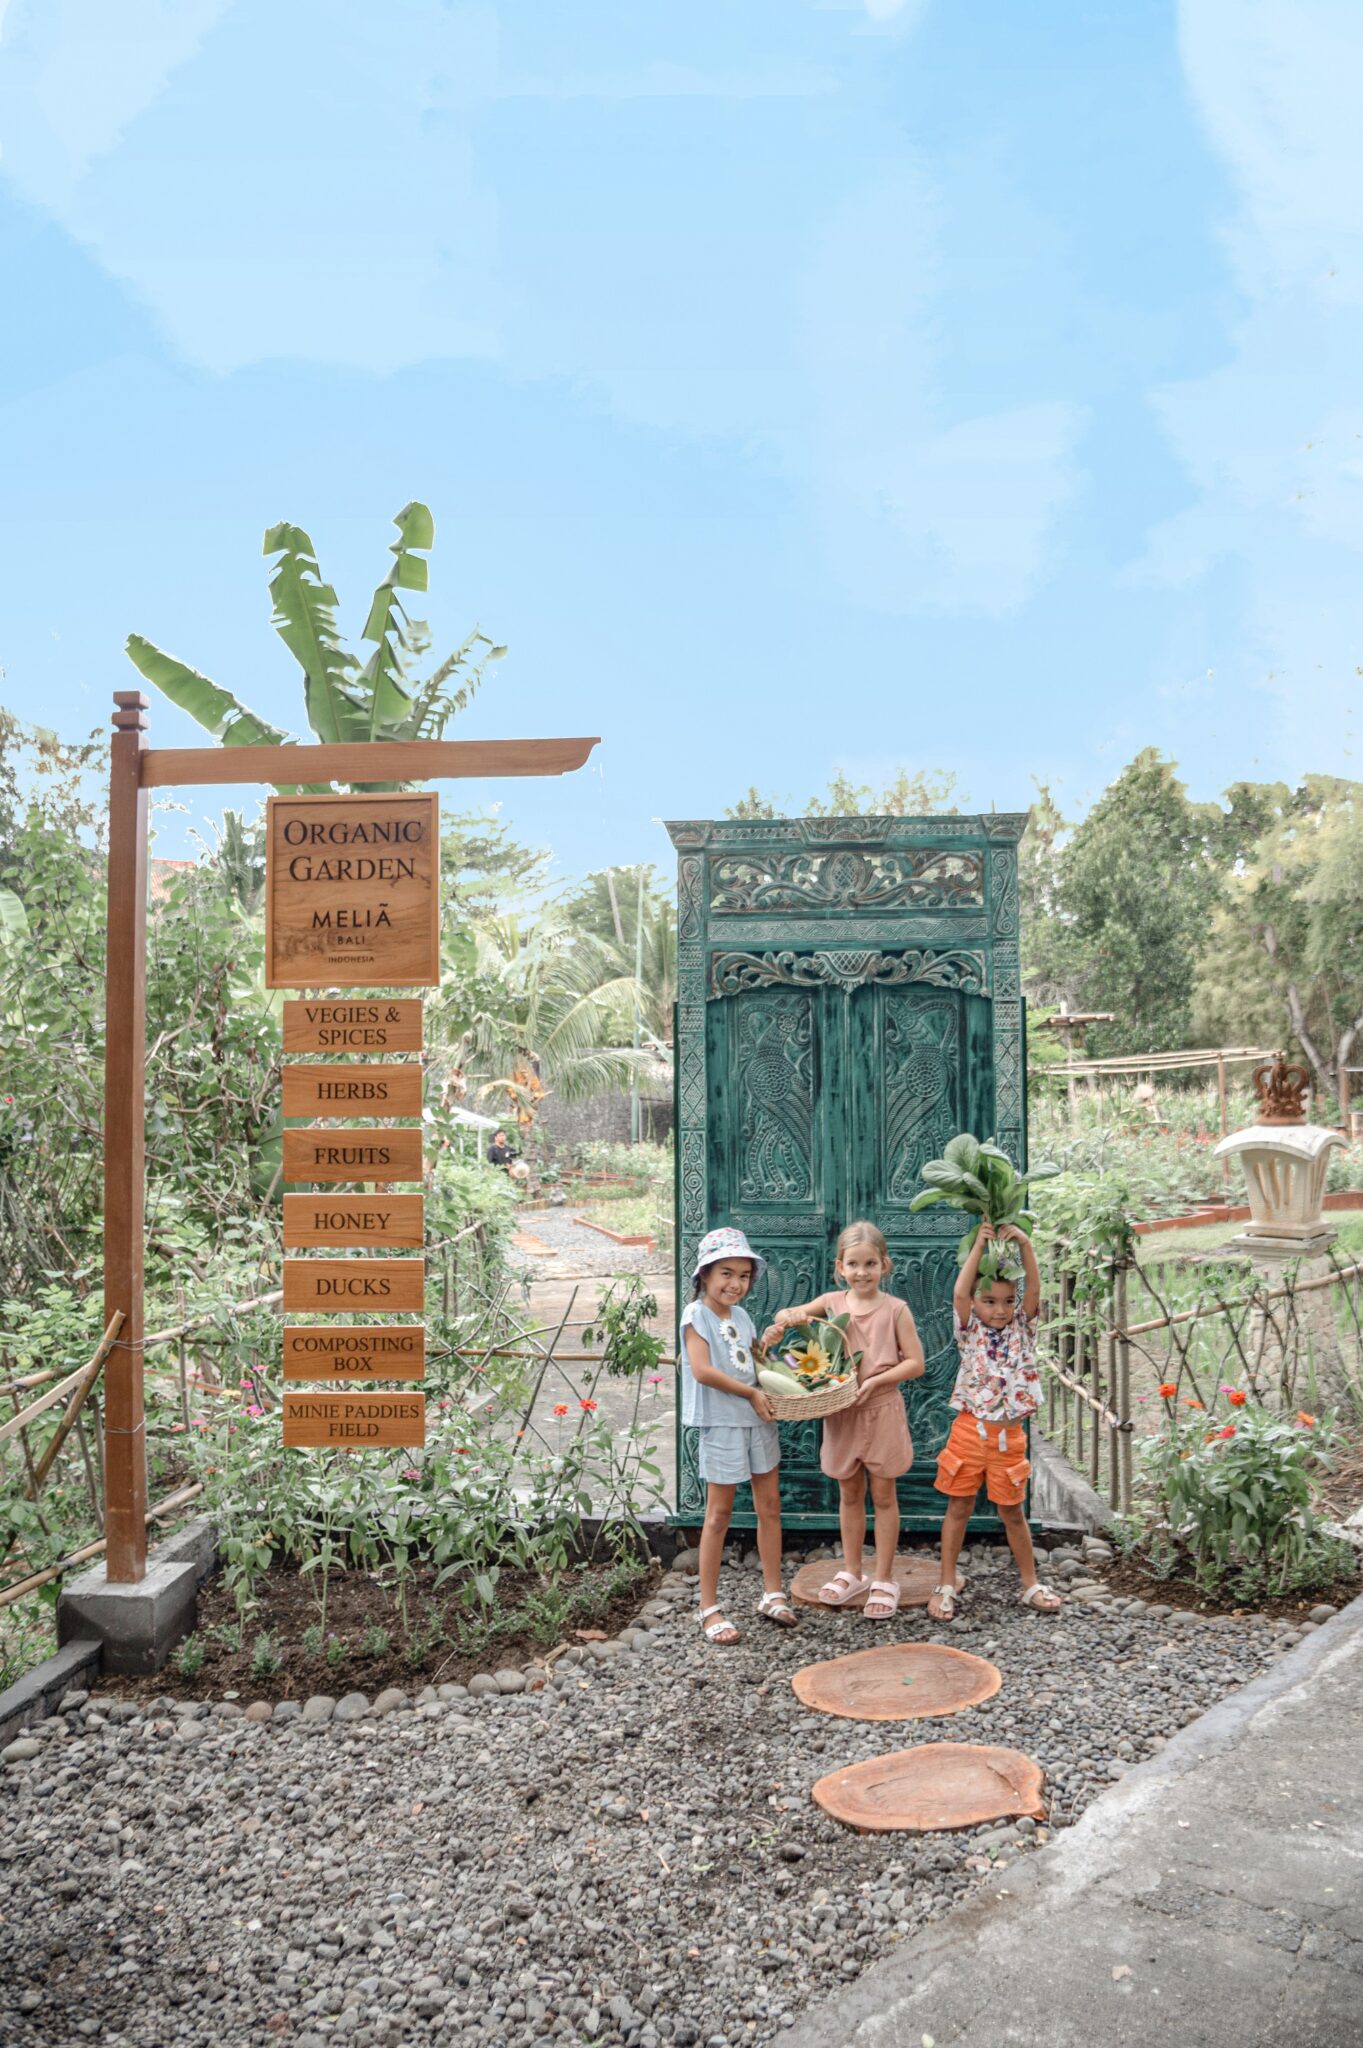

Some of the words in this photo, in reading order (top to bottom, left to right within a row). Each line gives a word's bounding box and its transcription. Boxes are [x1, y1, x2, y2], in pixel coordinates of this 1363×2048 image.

[284, 820, 422, 846] ORGANIC
[289, 856, 416, 881] GARDEN
[337, 936, 365, 945] BALI
[305, 1007, 379, 1024] VEGIES
[385, 1006, 401, 1022] &
[318, 1029, 387, 1046] SPICES
[317, 1083, 388, 1100] HERBS
[314, 1147, 390, 1164] FRUITS
[314, 1213, 391, 1230] HONEY
[316, 1278, 391, 1296] DUCKS
[292, 1337, 414, 1352] COMPOSTING
[333, 1357, 373, 1371] BOX
[288, 1405, 339, 1418] MINIE
[345, 1404, 420, 1418] PADDIES
[328, 1423, 379, 1437] FIELD
